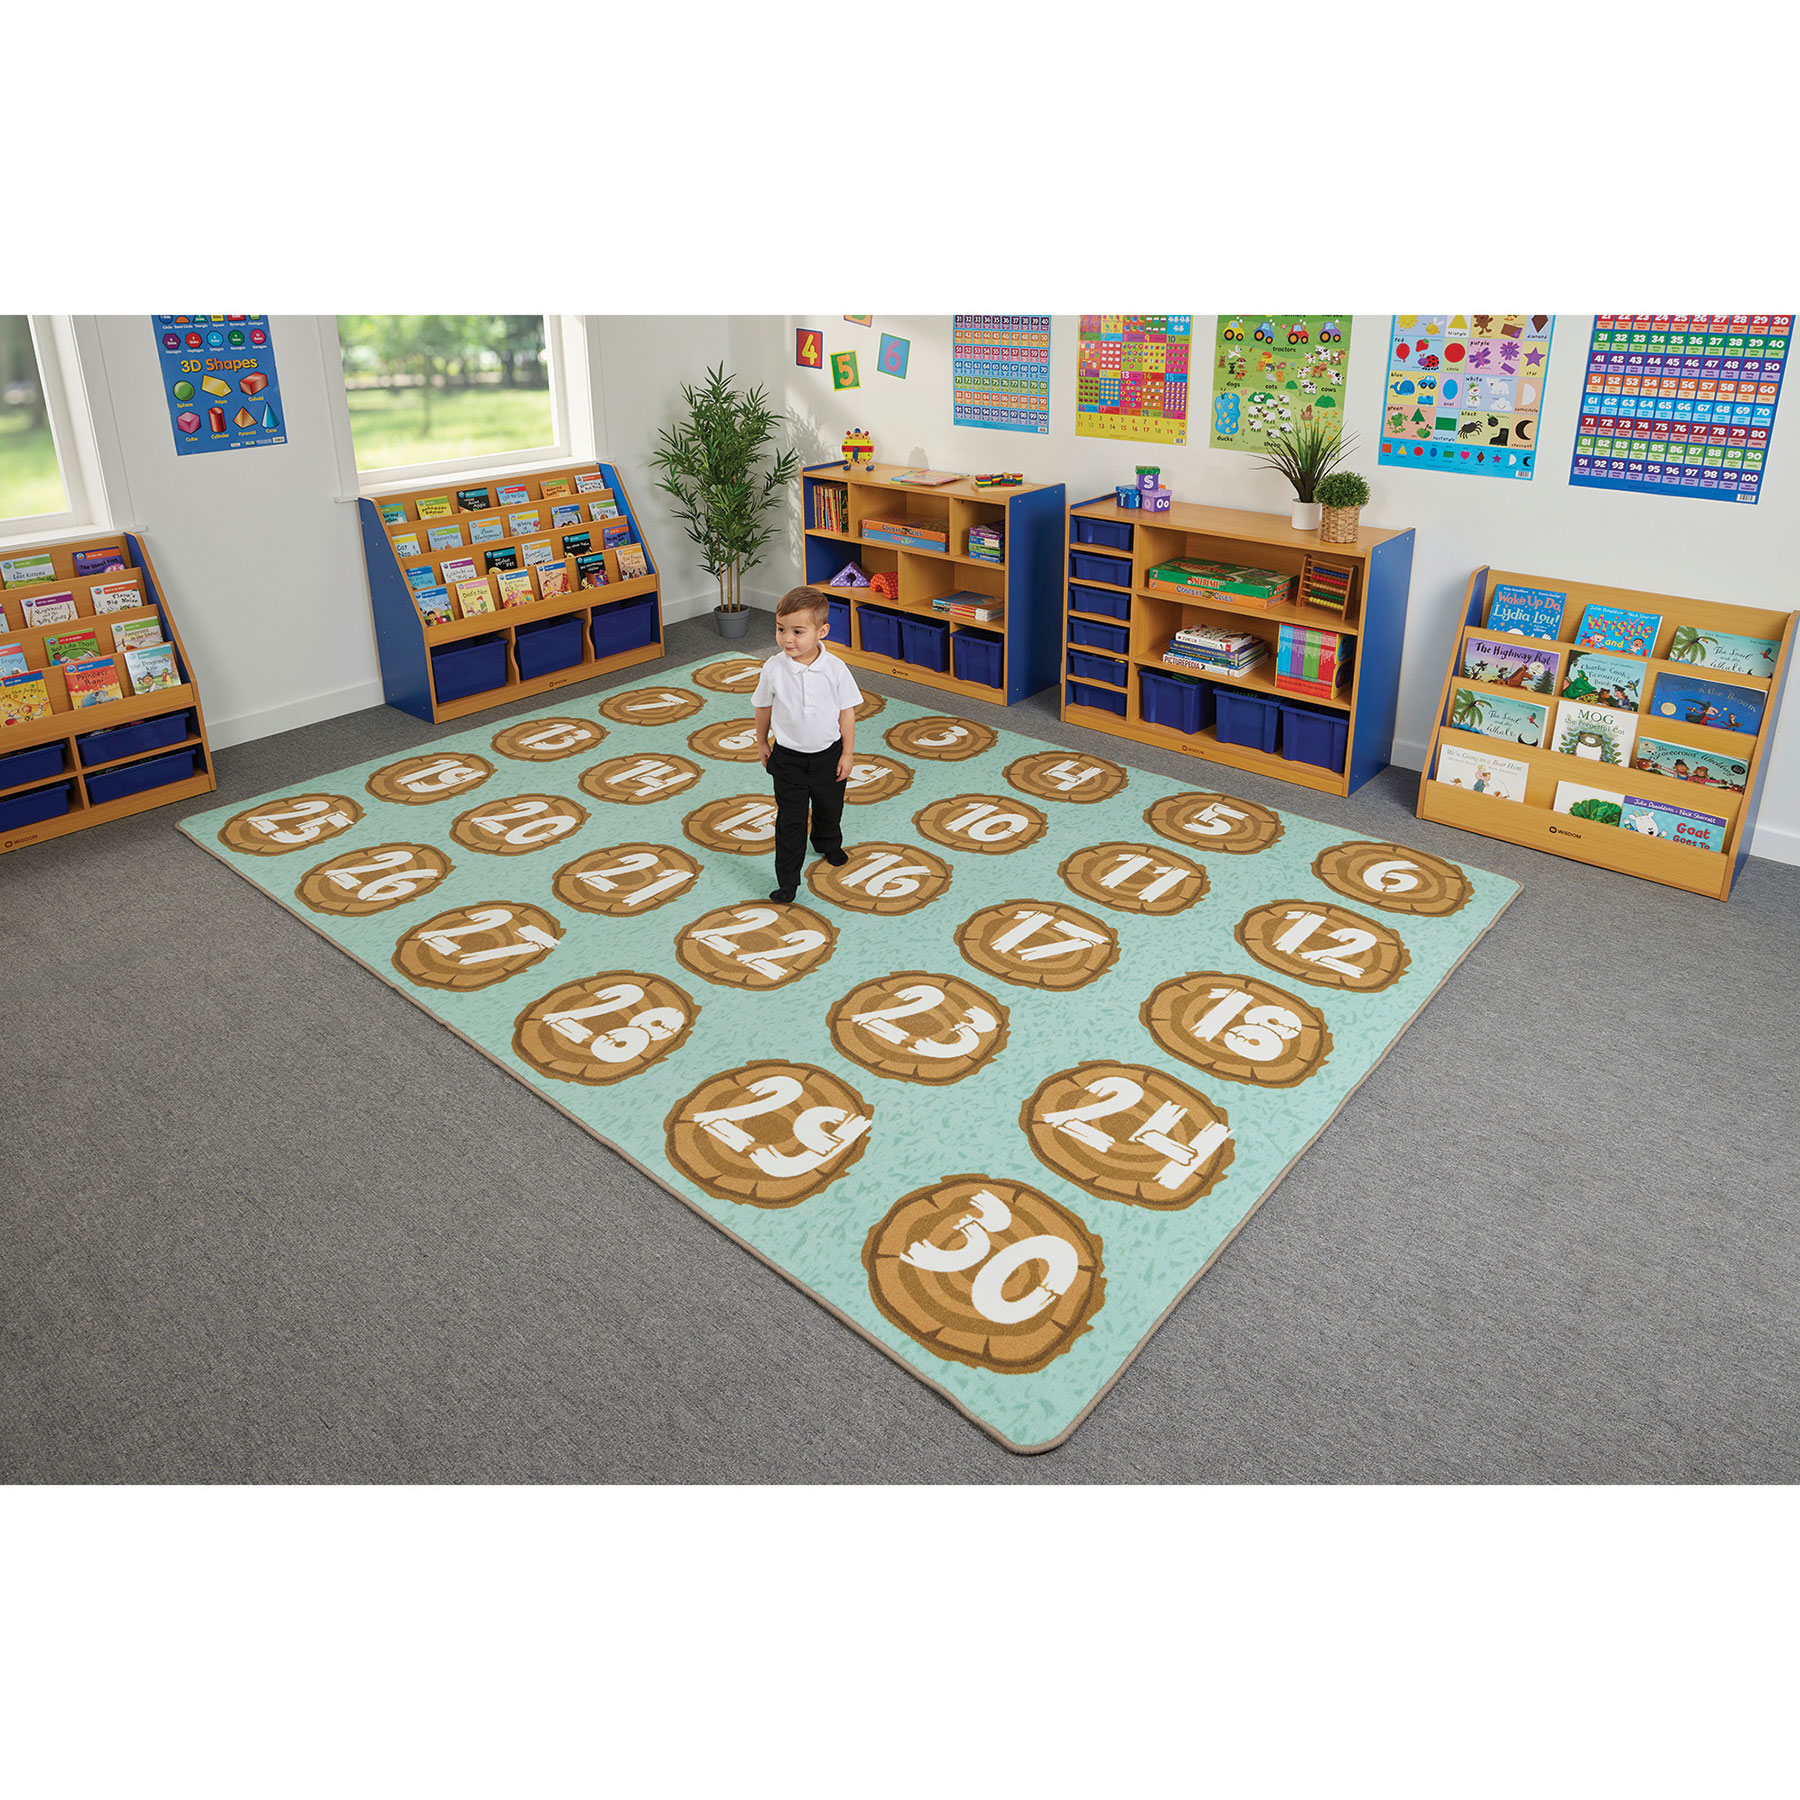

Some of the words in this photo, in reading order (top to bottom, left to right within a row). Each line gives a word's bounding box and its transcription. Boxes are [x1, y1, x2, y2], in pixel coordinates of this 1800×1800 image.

[1774, 316, 1788, 326] 30
[802, 334, 818, 365] 4
[1614, 334, 1628, 342] 32
[1728, 338, 1742, 346] 38
[181, 360, 202, 373] 3D
[205, 358, 258, 372] Shapes
[885, 340, 901, 372] 6
[1764, 362, 1780, 372] 50
[837, 354, 854, 386] 5
[1608, 376, 1620, 384] 52
[1760, 386, 1776, 394] 60
[1698, 404, 1710, 412] 67
[1756, 408, 1770, 416] 70
[1656, 422, 1668, 430] 75
[1750, 430, 1766, 438] 80
[1746, 452, 1762, 460] 90
[1144, 475, 1153, 488] S
[1648, 464, 1660, 474] 95
[1742, 474, 1758, 482] 100
[1499, 592, 1526, 605] Wake
[1528, 596, 1543, 609] Up
[1493, 604, 1530, 621] Lydia
[1533, 612, 1560, 627] Lou!
[1588, 614, 1653, 641] Wriggle
[1476, 642, 1491, 653] The
[1493, 645, 1532, 663] Highway
[1534, 652, 1551, 665] Rat
[1605, 640, 1624, 648] and
[1164, 656, 1200, 670] PICTUREPEDIA
[76, 670, 108, 681] Princess
[1727, 692, 1756, 712] Broom
[1502, 712, 1522, 724] Snail
[1578, 709, 1614, 724] MOG
[1579, 720, 1610, 732] Forgetful
[1612, 726, 1625, 735] Cat
[519, 724, 592, 750] 13
[914, 726, 969, 746] 3
[1487, 724, 1515, 736] Whale
[606, 759, 693, 797] 14
[1042, 760, 1103, 791] 4
[247, 801, 354, 844] 25
[471, 801, 577, 845] 20
[946, 803, 1029, 842] 10
[1184, 802, 1249, 836] 5
[1648, 802, 1674, 812] Donaldson
[1693, 813, 1716, 824] Sharratt
[13, 834, 38, 844] WISDOM
[1557, 830, 1582, 839] WISDOM
[1673, 835, 1697, 847] Goes
[1699, 842, 1710, 850] To
[1676, 823, 1710, 839] Goat
[325, 851, 438, 901] 26
[575, 853, 694, 907] 21
[841, 852, 931, 898] 16
[1101, 854, 1191, 903] 11
[1363, 860, 1419, 893] 6
[417, 909, 562, 965] 27
[691, 908, 826, 981] 22
[992, 911, 1109, 961] 17
[1273, 911, 1377, 979] 12
[542, 984, 685, 1063] 28
[852, 985, 997, 1059] 23
[1191, 988, 1302, 1062] 18
[693, 1076, 873, 1178] 29
[1044, 1076, 1237, 1190] 24
[900, 1189, 1078, 1324] 30
